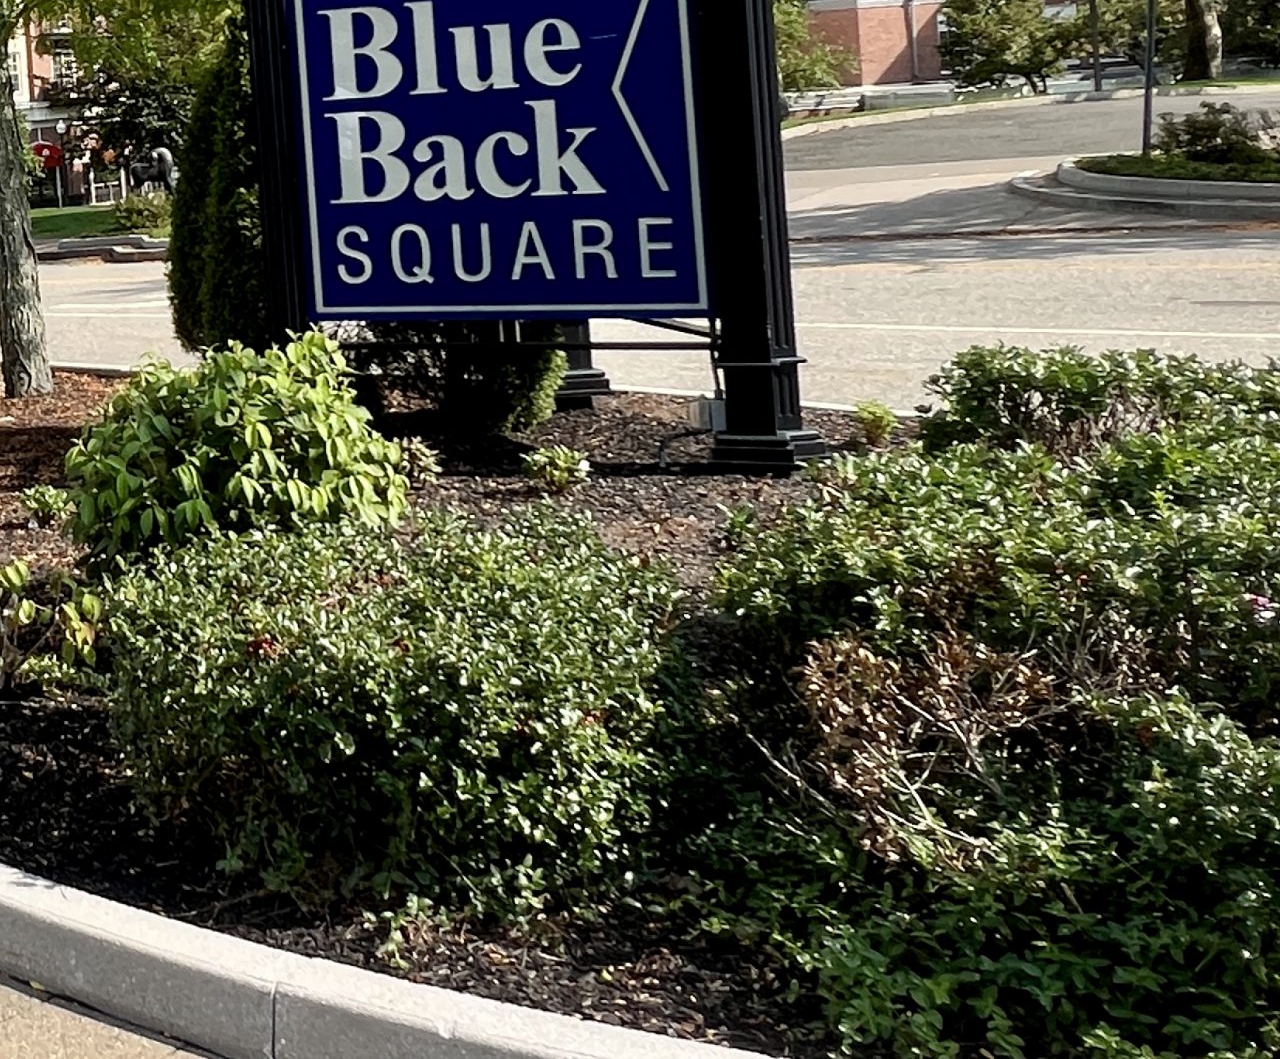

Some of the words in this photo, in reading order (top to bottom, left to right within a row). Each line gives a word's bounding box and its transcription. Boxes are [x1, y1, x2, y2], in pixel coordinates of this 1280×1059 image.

[317, 1, 582, 101] Blue
[324, 99, 606, 204] Back
[336, 217, 677, 285] SQUARE
